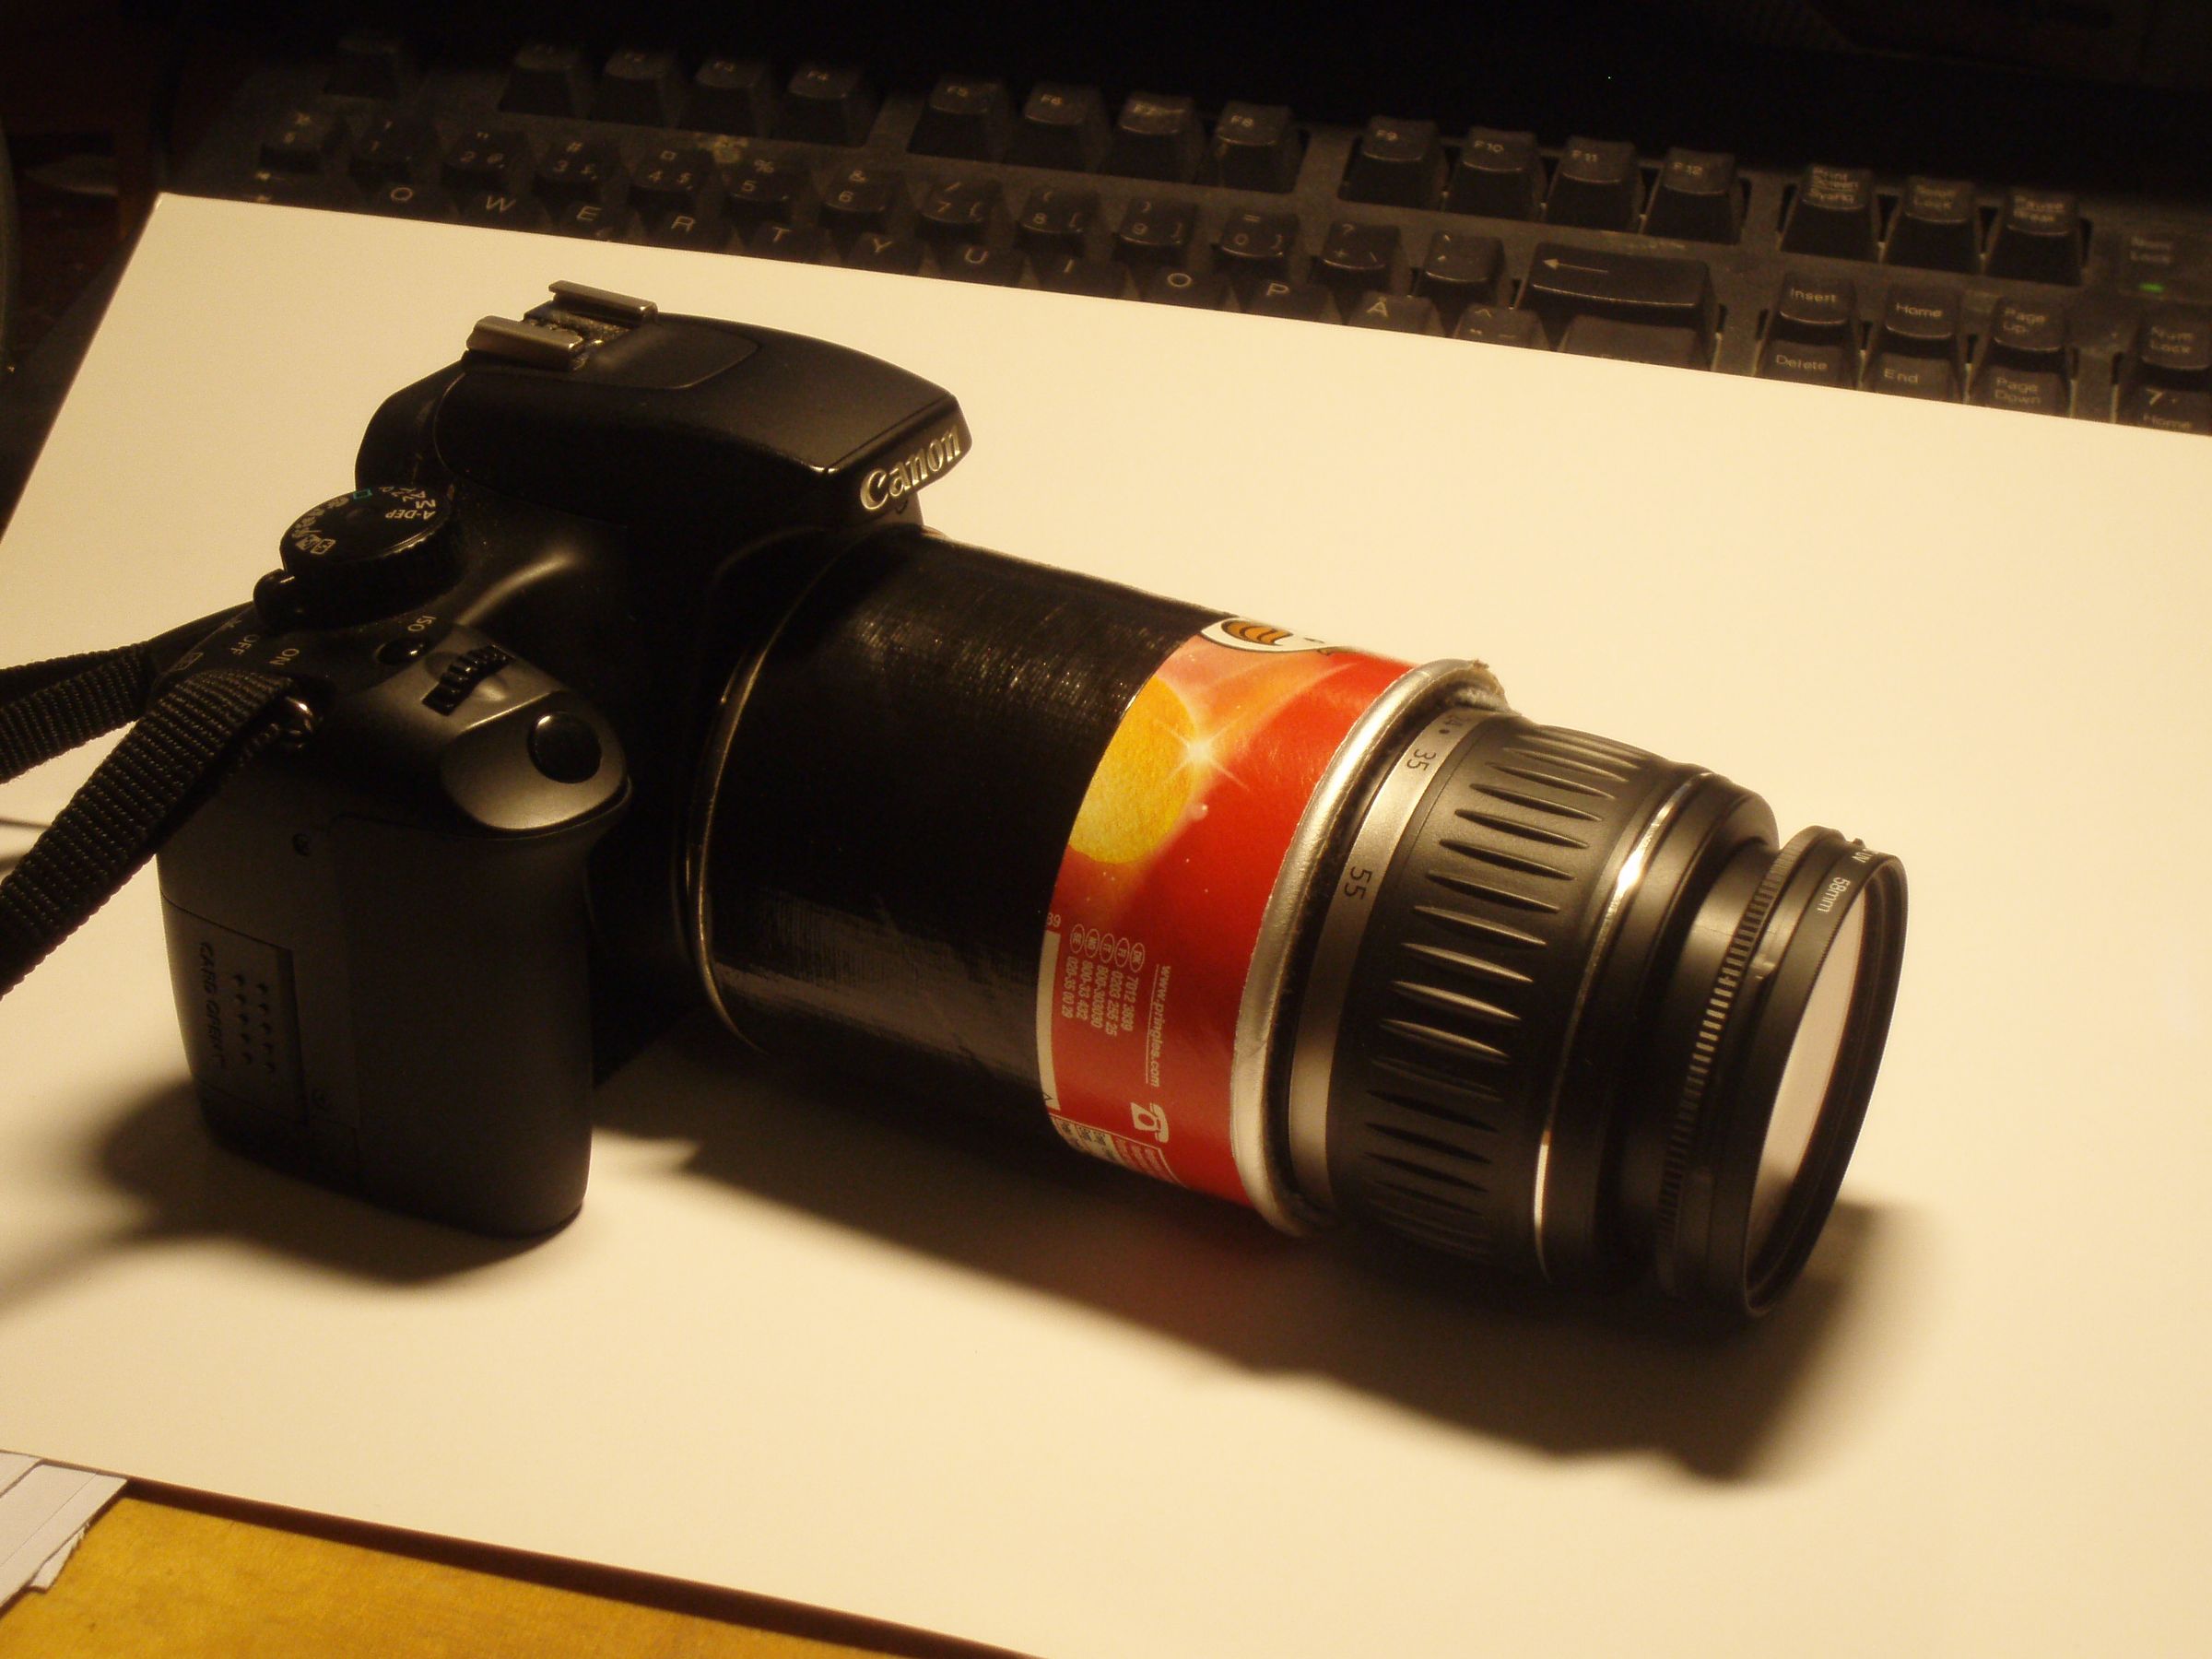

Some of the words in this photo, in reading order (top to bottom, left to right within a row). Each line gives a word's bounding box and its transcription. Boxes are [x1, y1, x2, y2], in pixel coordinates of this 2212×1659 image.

[1230, 113, 1254, 128] F8
[1375, 128, 1399, 142] F9
[1474, 139, 1505, 154] F10
[1571, 148, 1598, 163] F11
[1672, 161, 1703, 176] F12
[485, 194, 516, 214] W
[838, 190, 854, 204] 6
[575, 206, 602, 222] E
[1032, 212, 1047, 226] 8
[671, 214, 697, 232] R
[771, 226, 792, 243] T
[873, 237, 893, 253] Y
[964, 247, 989, 265] U
[1166, 272, 1193, 288] O
[1265, 281, 1290, 298] P
[1790, 288, 1838, 303] Insert
[1896, 301, 1944, 319] Home
[2004, 307, 2049, 324] Page
[1775, 353, 1829, 371] Delete
[1883, 367, 1920, 384] End
[1995, 376, 2039, 394] Page
[2146, 385, 2164, 406] 7
[859, 424, 962, 512] Canon
[415, 499, 437, 510] M
[384, 508, 438, 522] A-DEP
[406, 615, 438, 632] ISO
[268, 647, 300, 666] ON
[1406, 747, 1437, 772] 35
[1343, 865, 1373, 900] 55
[1817, 877, 1852, 912] 58mm
[199, 941, 218, 995] CARD
[1124, 975, 1139, 1004] 7012
[1105, 1021, 1118, 1037] 25
[1150, 965, 1171, 1088] www.pringles.com
